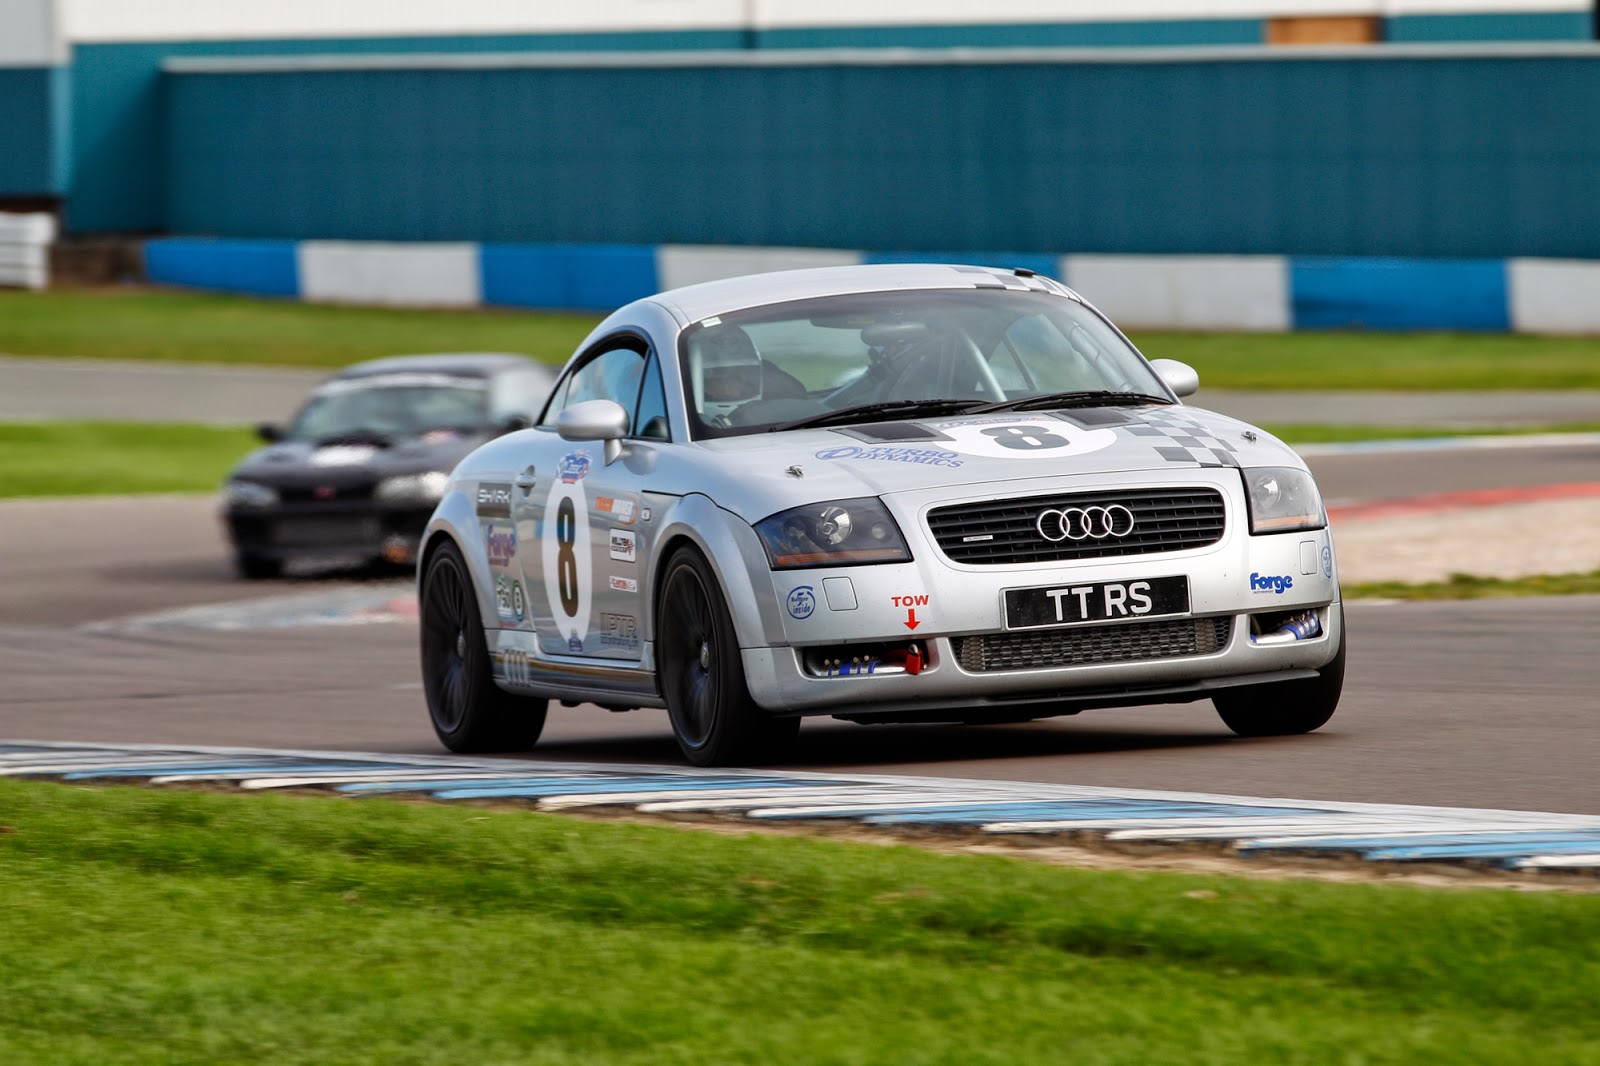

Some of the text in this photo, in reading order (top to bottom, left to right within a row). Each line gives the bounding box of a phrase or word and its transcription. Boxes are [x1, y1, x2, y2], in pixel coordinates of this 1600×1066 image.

[979, 425, 1071, 450] 8
[853, 453, 964, 468] DYNAMICS
[867, 447, 959, 459] TURBO
[556, 496, 579, 617] 8
[1249, 572, 1293, 594] Forge
[891, 595, 929, 607] TOW
[1046, 581, 1153, 622] TT RS
